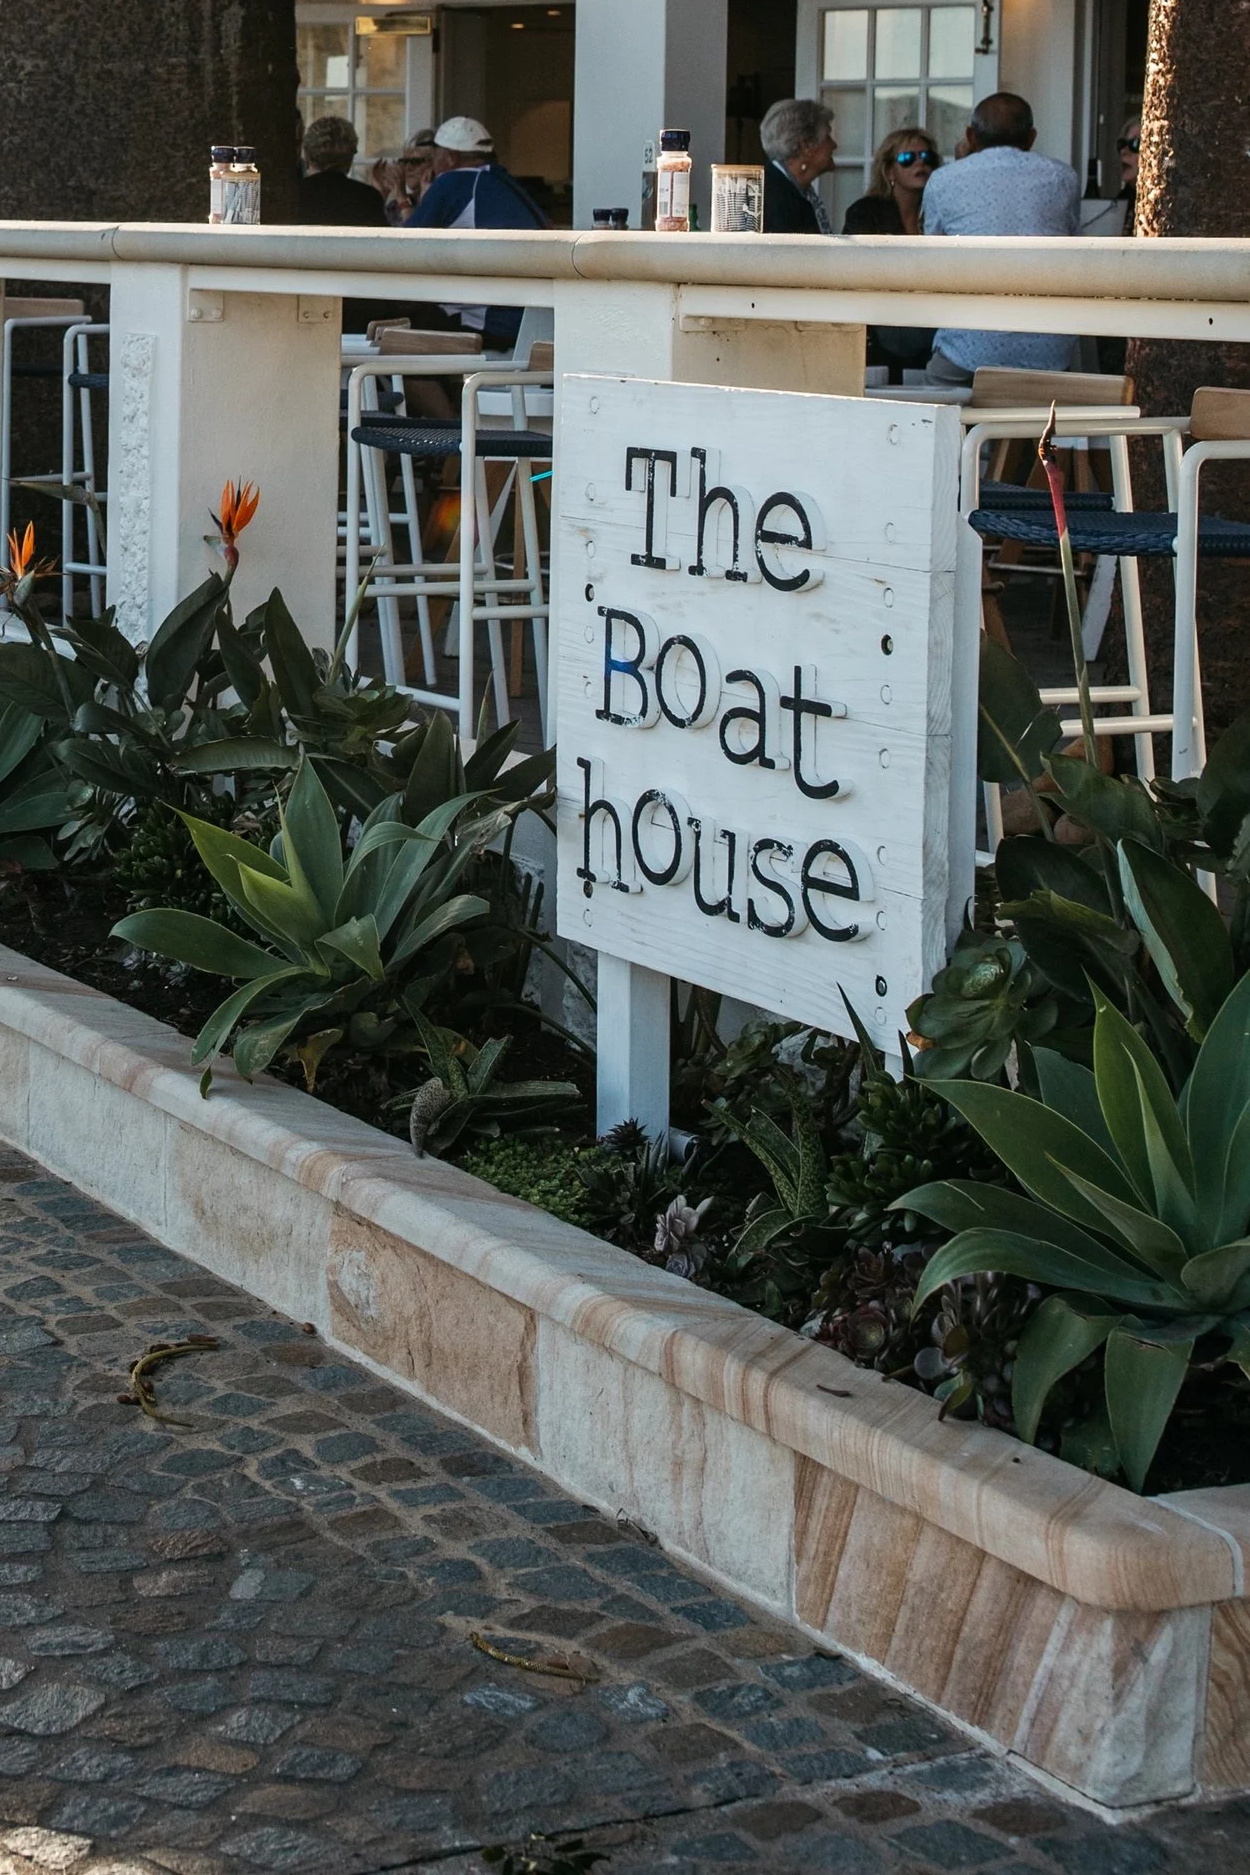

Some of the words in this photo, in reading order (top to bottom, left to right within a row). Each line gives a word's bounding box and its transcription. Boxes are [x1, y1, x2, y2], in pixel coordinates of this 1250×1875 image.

[626, 446, 820, 592] The
[595, 605, 847, 800] Boat
[576, 756, 865, 943] house
